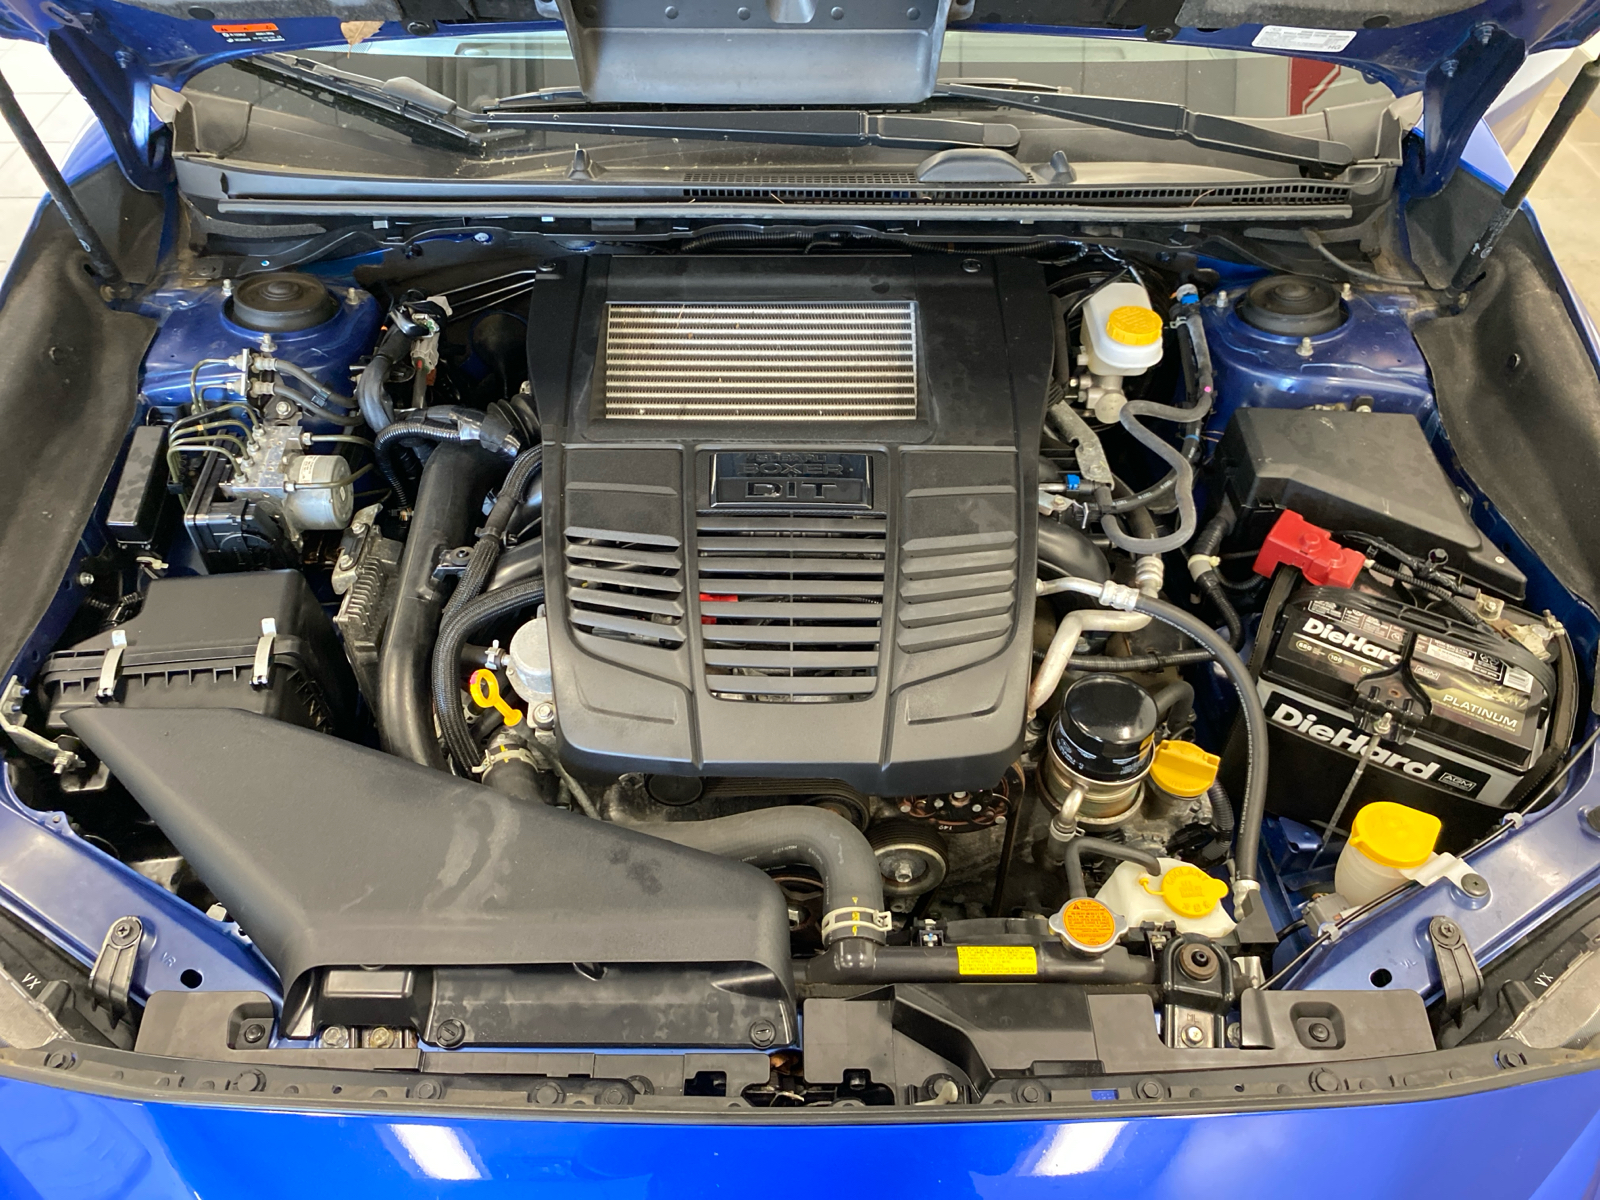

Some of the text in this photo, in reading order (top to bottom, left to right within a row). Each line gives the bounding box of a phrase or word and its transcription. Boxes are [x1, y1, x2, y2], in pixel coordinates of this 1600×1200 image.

[755, 453, 827, 462] SUBARU
[738, 463, 843, 475] BOXER
[745, 481, 838, 499] DIT
[1417, 666, 1439, 677] AGM
[1443, 694, 1518, 728] PLATINUM
[1271, 703, 1442, 780] DieHard
[1444, 774, 1474, 788] AGM
[21, 972, 42, 990] VX
[1534, 971, 1554, 987] VX
